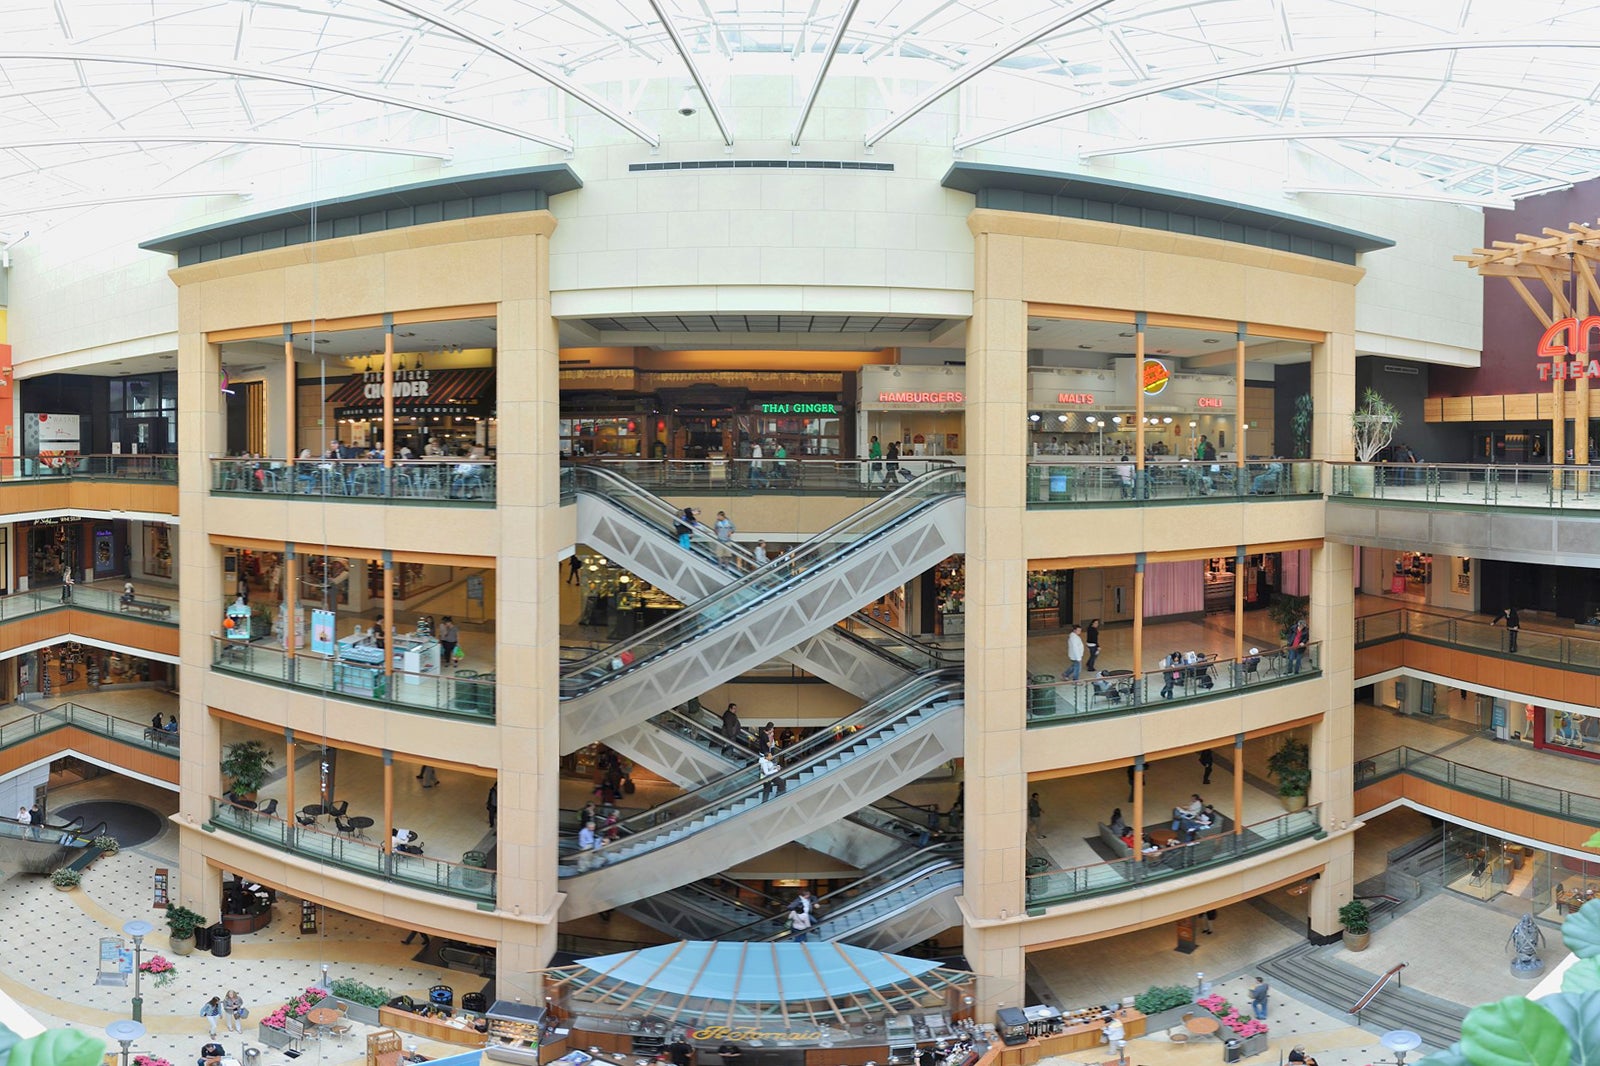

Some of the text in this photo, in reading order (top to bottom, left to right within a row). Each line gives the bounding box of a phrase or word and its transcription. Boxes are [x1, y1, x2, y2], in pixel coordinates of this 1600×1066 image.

[879, 391, 962, 403] HAMBURGERS
[1058, 393, 1094, 404] MALTS
[1198, 397, 1222, 407] CHILI
[762, 403, 837, 413] THAI GINGER
